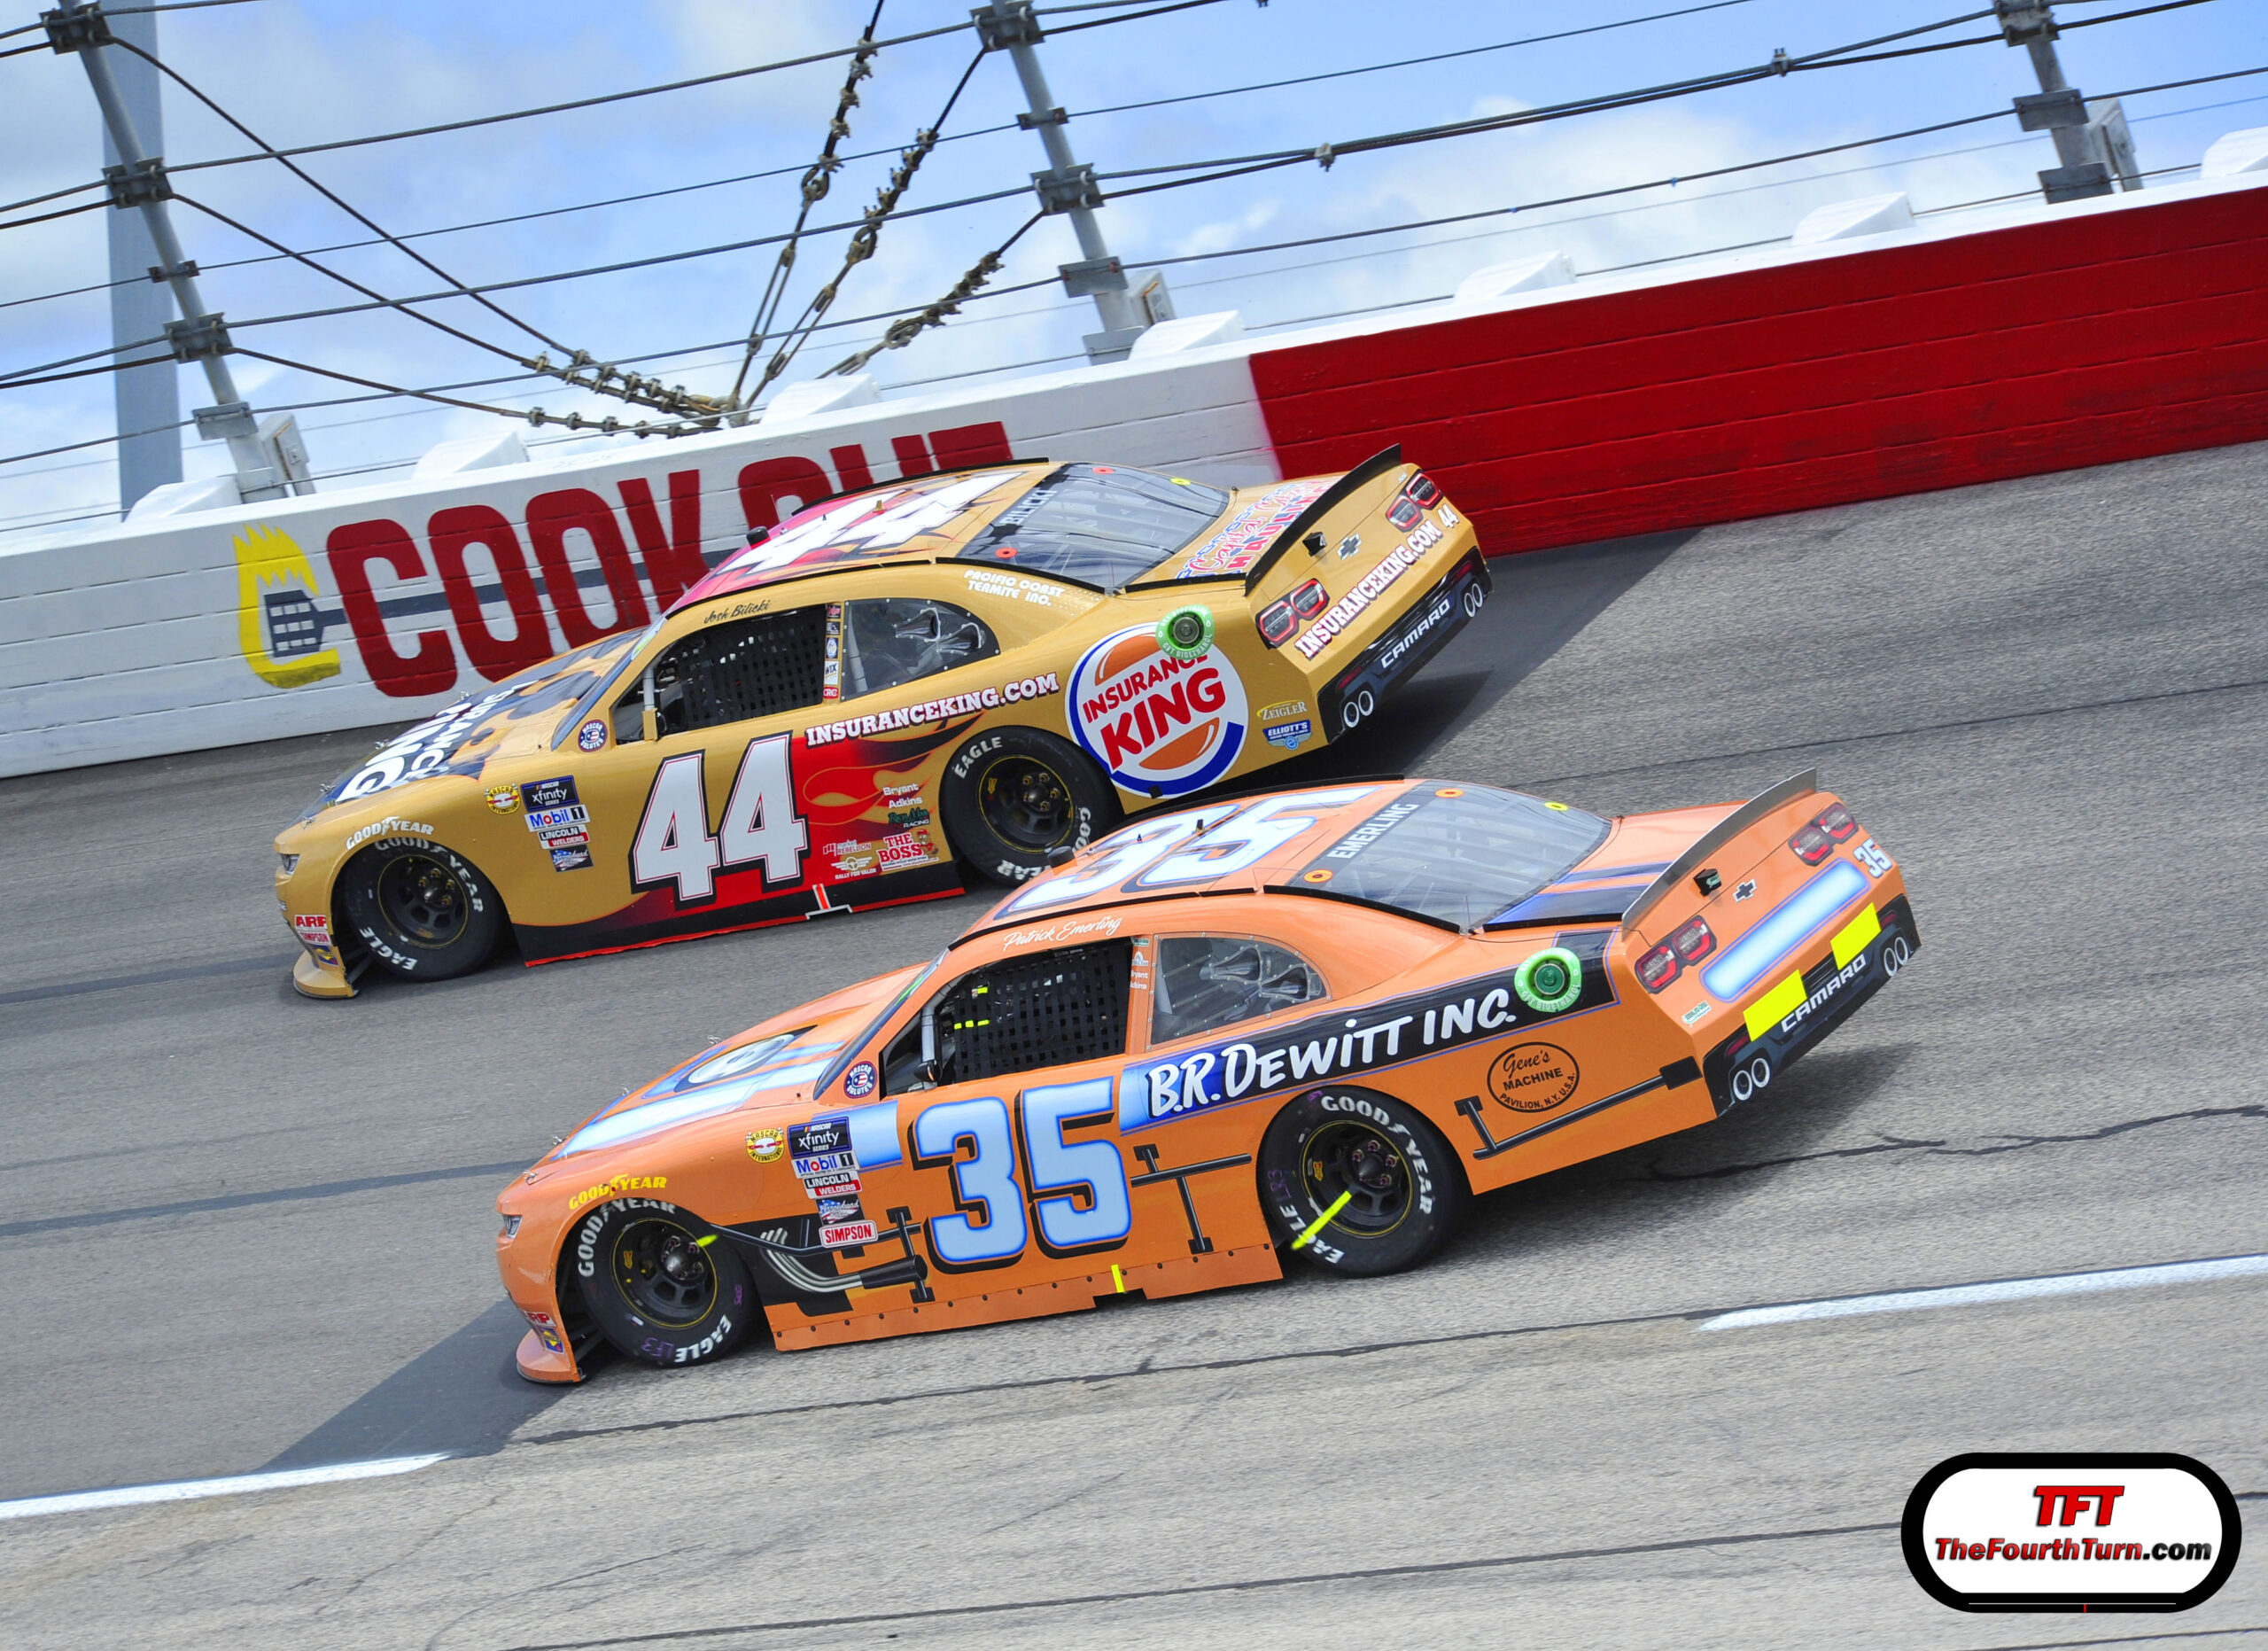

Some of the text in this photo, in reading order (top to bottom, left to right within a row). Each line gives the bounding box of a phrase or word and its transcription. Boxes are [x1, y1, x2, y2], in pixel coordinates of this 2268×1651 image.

[1438, 503, 1459, 528] 44
[326, 470, 711, 697] COOK
[968, 580, 1021, 599] TERMITE
[1019, 580, 1065, 597] COAST
[1294, 519, 1442, 659] INSURANCEKING.COM
[703, 600, 771, 624] Josh Bilicki
[1381, 598, 1451, 669] CAMARO
[1083, 654, 1208, 724] INSURAN
[805, 672, 1060, 747] INSURANCEKING.COM
[1100, 667, 1226, 770] KING
[1262, 701, 1308, 720] ZEIGLER
[954, 736, 1003, 779] EAGLE
[532, 788, 568, 805] xfinity
[882, 783, 920, 796] Bryant
[889, 797, 923, 809] Adkins
[529, 809, 570, 828] Mobil
[572, 806, 581, 820] 1
[631, 732, 808, 905] 44
[904, 819, 929, 829] RACING
[346, 816, 434, 850] GOODYEAR
[540, 827, 579, 840] LINCOLN
[552, 836, 585, 846] WELDERS
[885, 834, 913, 847] THE
[1326, 804, 1420, 859] EMERLING
[836, 842, 872, 855] REBELLION
[878, 843, 923, 862] BOSS
[1008, 785, 1384, 913] 35
[1853, 837, 1892, 878] 35
[1003, 916, 1122, 952] Patrick Emerling
[360, 927, 418, 971] EAGLE
[1781, 954, 1867, 1033] CAMARO
[1423, 988, 1517, 1045] INC.
[850, 1063, 872, 1078] NASCAR
[1503, 1050, 1550, 1079] Gene's
[847, 1081, 873, 1095] SALUTES
[1500, 1072, 1575, 1109] PAVILION, N.Y. U.S.A.
[1503, 1068, 1564, 1091] MACHINE
[750, 1130, 778, 1142] NASCAR
[798, 1131, 839, 1149] xfinity
[796, 1155, 837, 1173] Mobil
[843, 1154, 850, 1166] 1
[1321, 1095, 1434, 1215] GOODYEAR
[806, 1173, 850, 1188] LINCOLN
[916, 1076, 1132, 1262] 35
[568, 1174, 667, 1210] GOODYEAR
[819, 1184, 856, 1195] WELDERS
[578, 1197, 677, 1277] GOODYEAR
[825, 1224, 872, 1243] SIMPSON
[523, 1312, 550, 1324] RP
[674, 1314, 732, 1363] EAGLE
